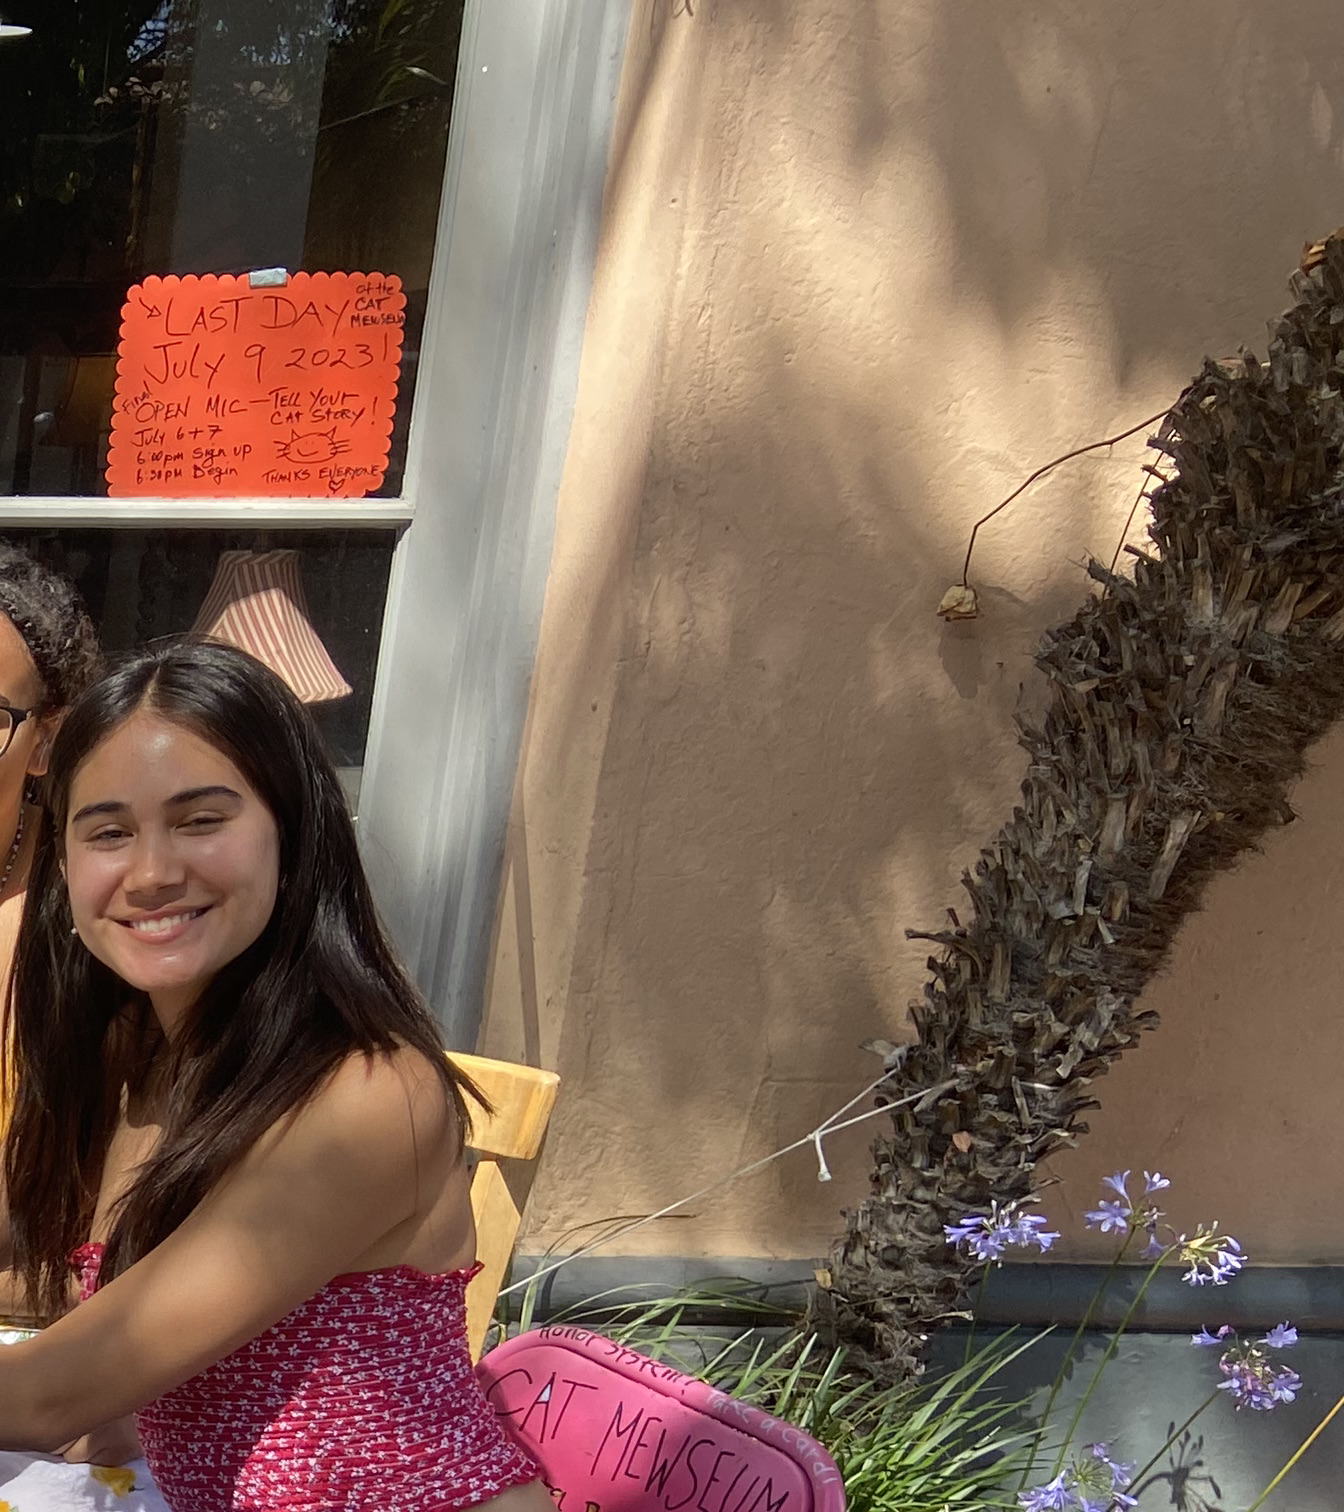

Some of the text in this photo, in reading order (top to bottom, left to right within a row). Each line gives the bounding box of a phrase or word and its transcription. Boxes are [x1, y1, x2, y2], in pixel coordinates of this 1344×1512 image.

[165, 295, 350, 337] LAST DAY
[354, 296, 391, 312] CAT
[244, 343, 267, 384] 9
[135, 394, 191, 424] OPEN
[205, 393, 249, 418] MIC
[176, 426, 185, 441] 6
[485, 1367, 599, 1444] CAT
